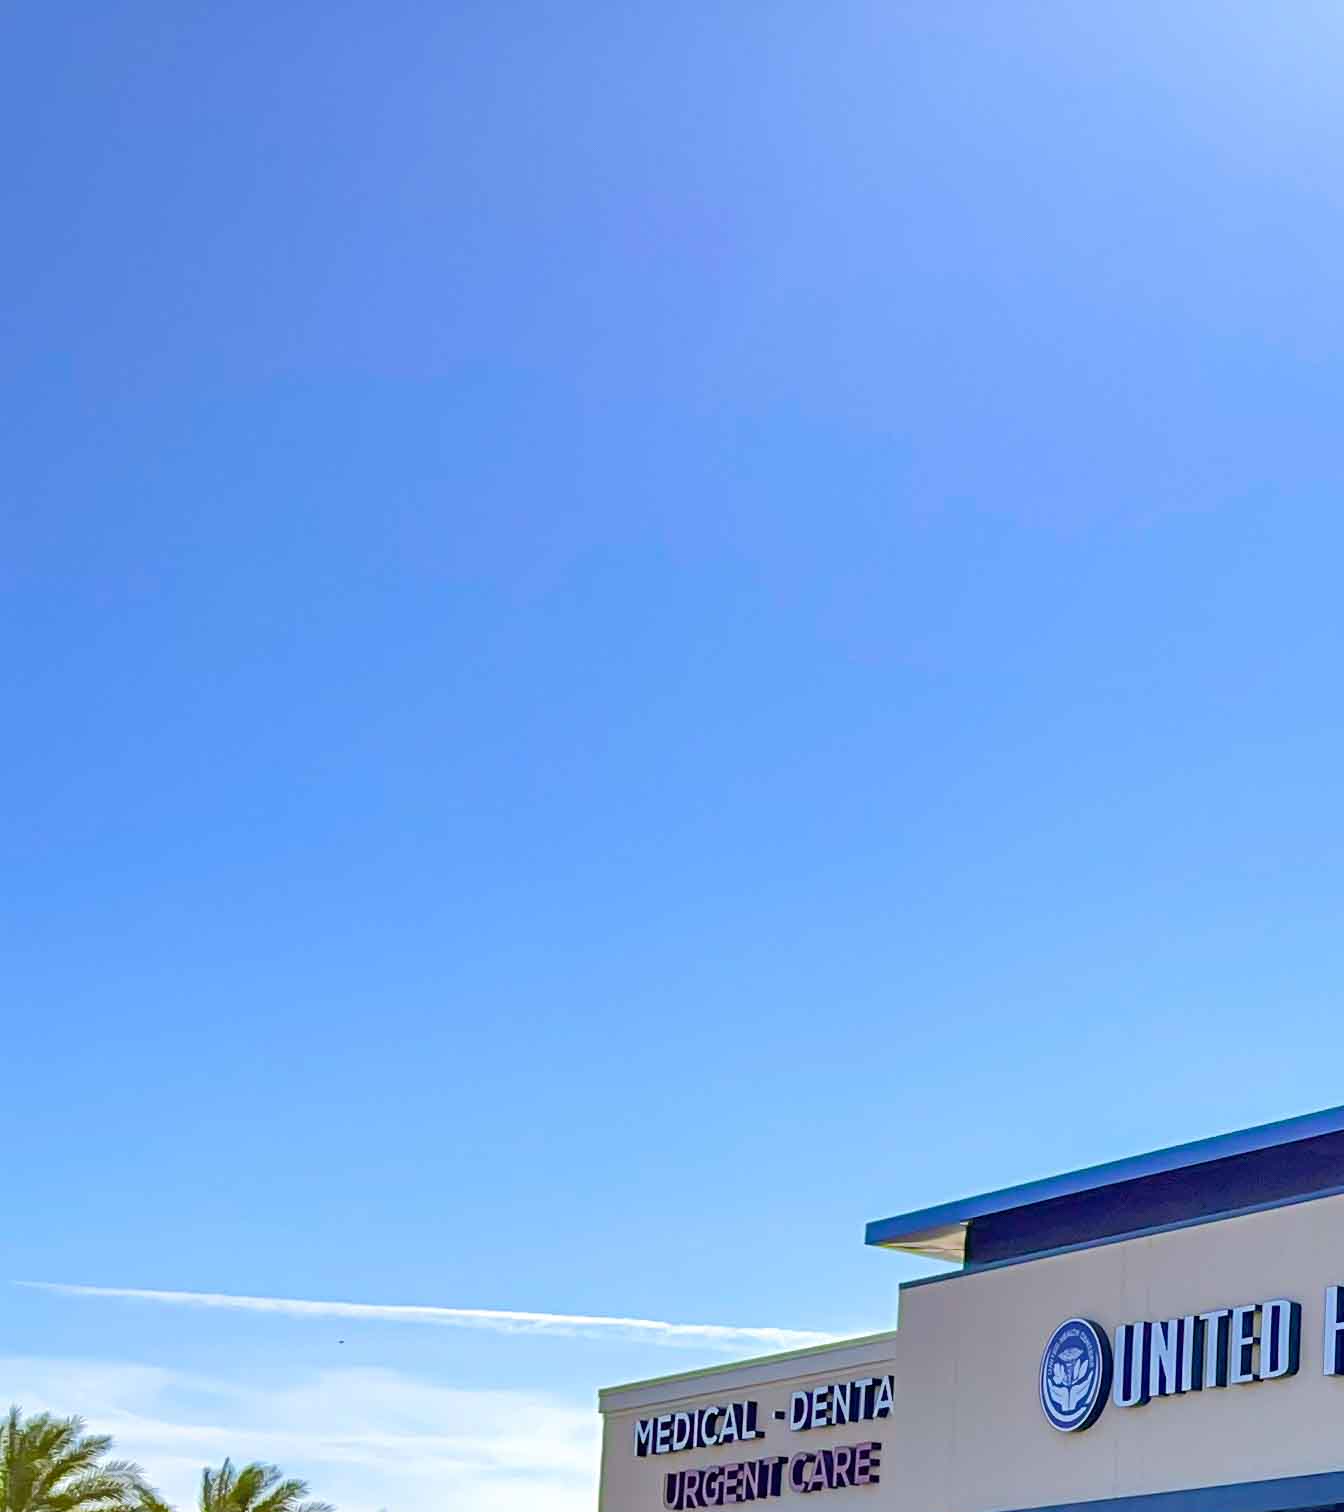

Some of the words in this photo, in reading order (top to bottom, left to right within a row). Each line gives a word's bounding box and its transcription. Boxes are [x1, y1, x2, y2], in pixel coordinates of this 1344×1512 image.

[1113, 1299, 1301, 1408] UNITED
[634, 1400, 765, 1457] MEDICAL
[663, 1456, 789, 1511] URGENT
[789, 1441, 882, 1493] CARE
